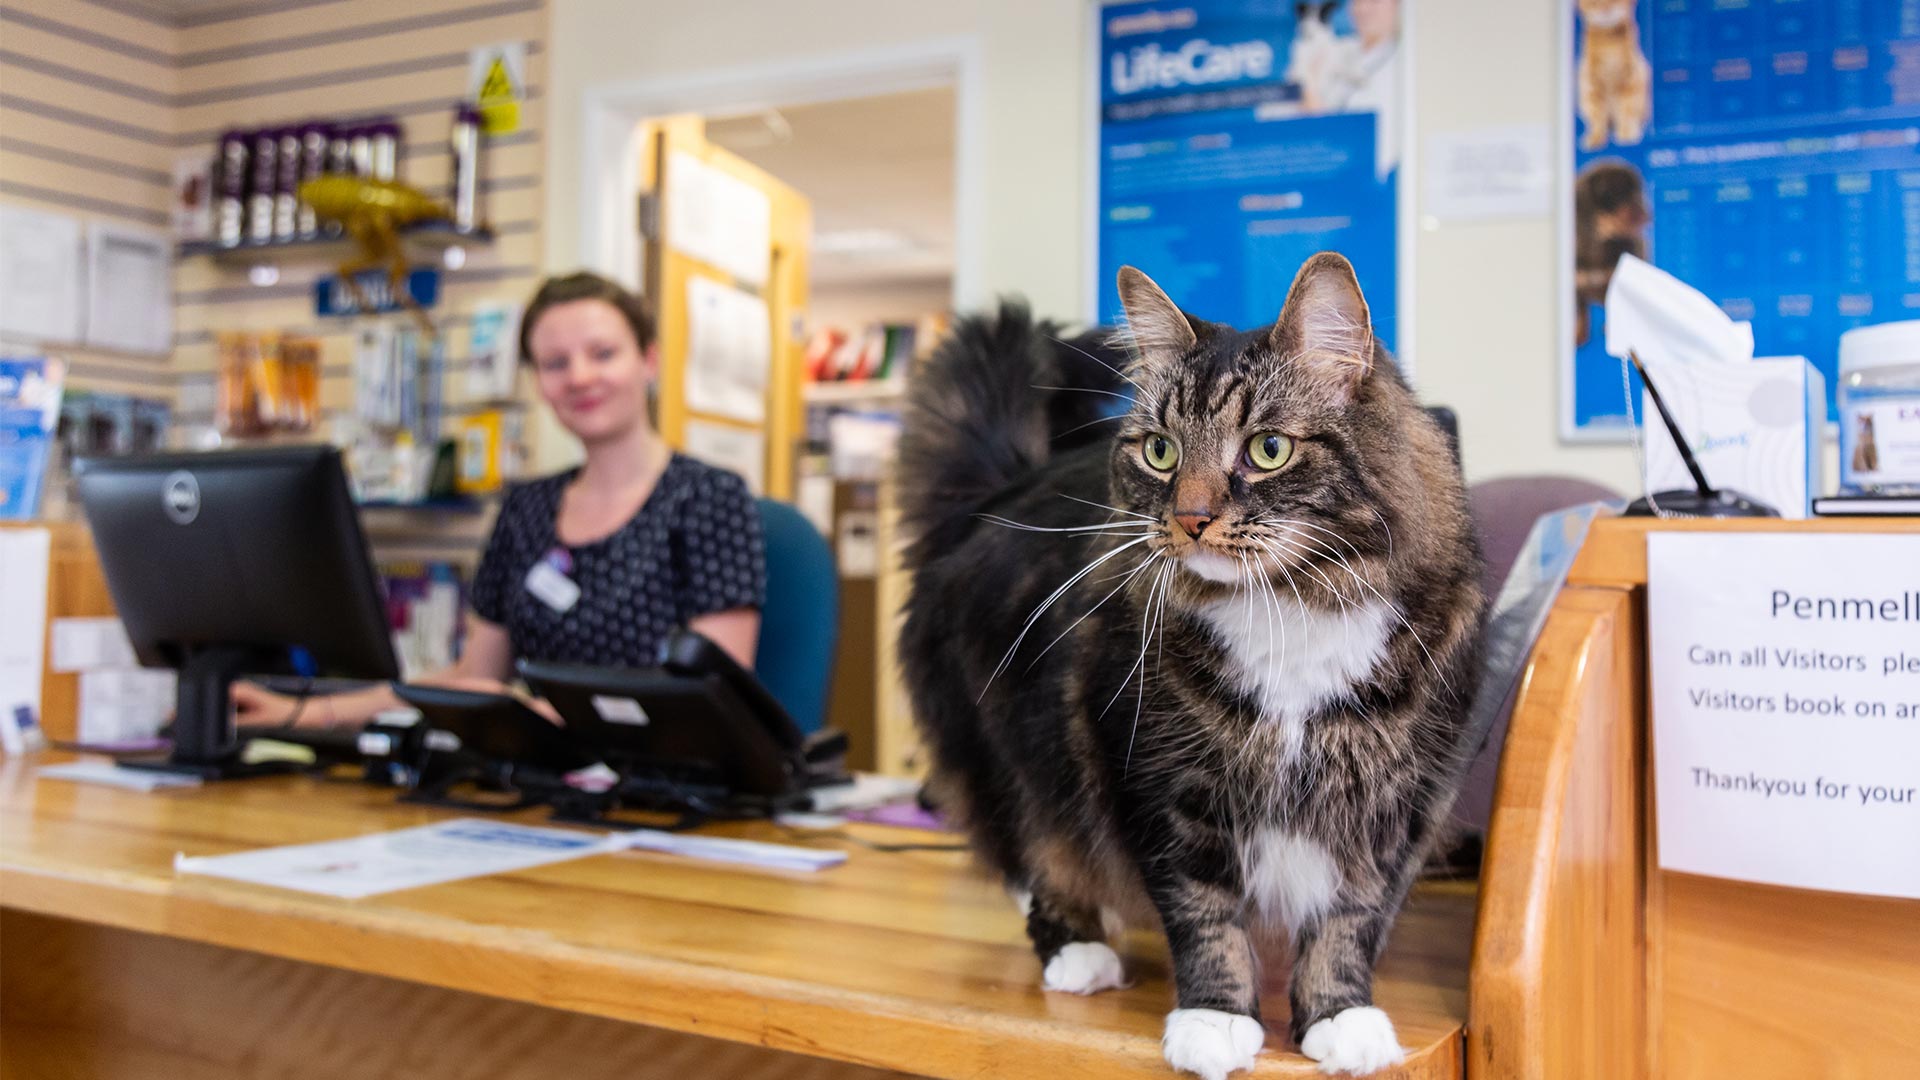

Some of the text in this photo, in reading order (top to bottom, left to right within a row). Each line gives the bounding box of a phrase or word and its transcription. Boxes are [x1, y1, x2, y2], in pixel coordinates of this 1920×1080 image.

[1112, 39, 1273, 94] LifeCare
[1771, 590, 1920, 621] Penmell
[1689, 645, 1920, 676] Can all Visitors ple
[1689, 688, 1776, 713] Visitors
[1785, 692, 1846, 716] book
[1855, 701, 1886, 717] on
[1691, 767, 1916, 805] Thankyou for your
